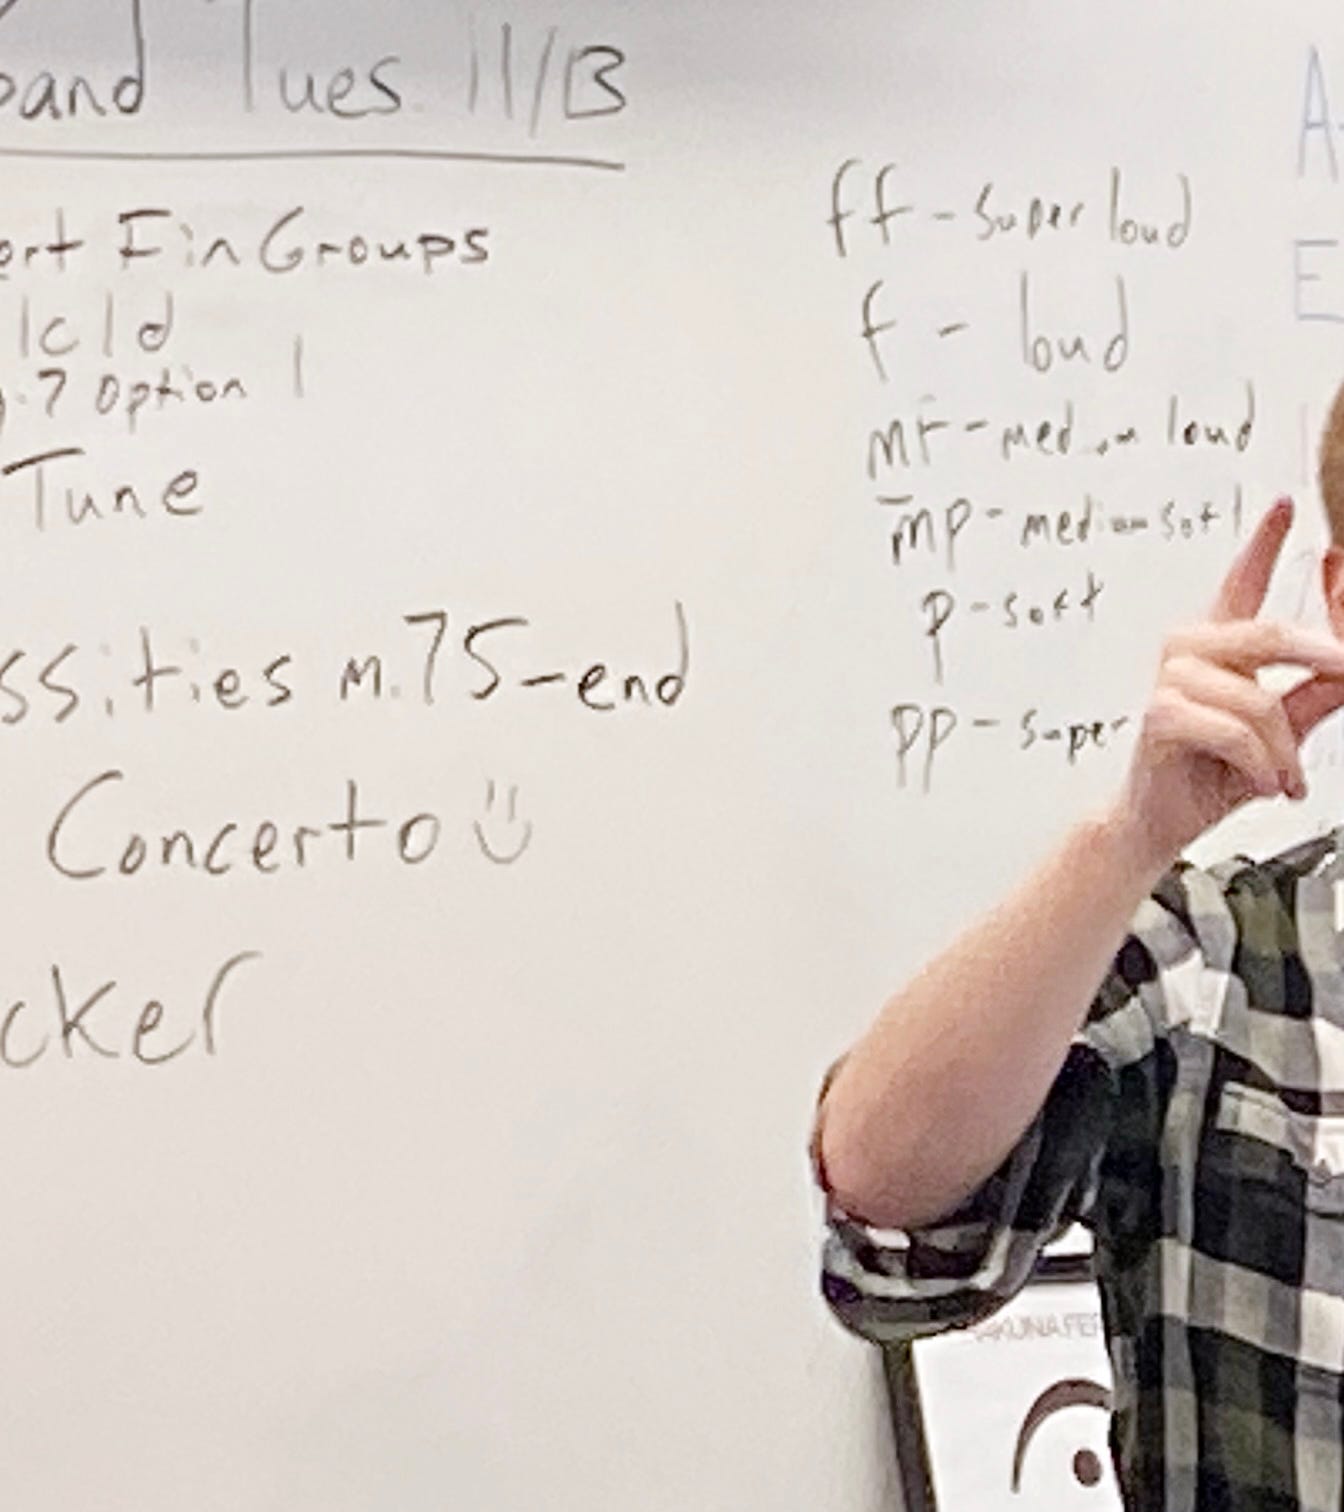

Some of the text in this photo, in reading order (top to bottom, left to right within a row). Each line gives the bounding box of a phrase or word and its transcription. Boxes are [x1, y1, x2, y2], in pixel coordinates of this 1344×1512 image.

[1109, 166, 1192, 248] loud
[1019, 270, 1130, 372] loud
[1167, 380, 1256, 453] loud
[2, 446, 203, 530] Tune
[47, 769, 440, 879] Concerto
